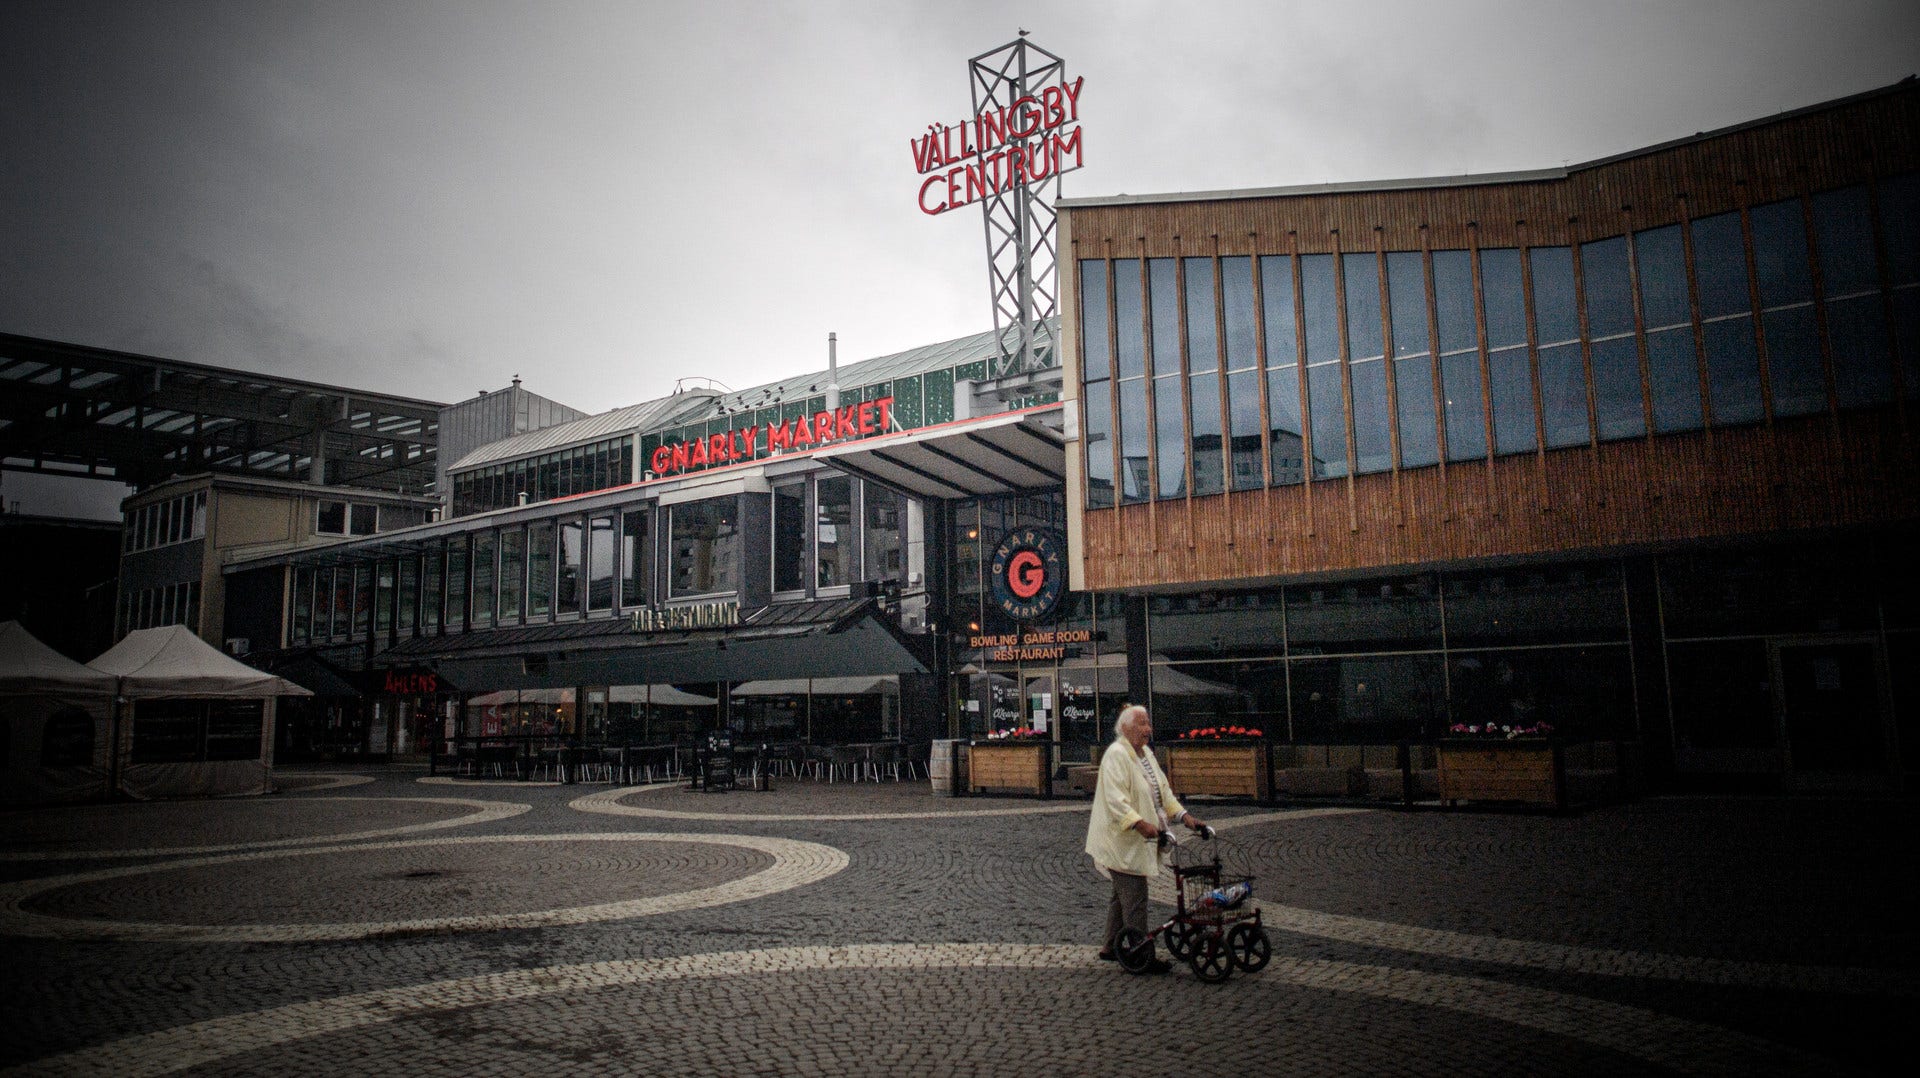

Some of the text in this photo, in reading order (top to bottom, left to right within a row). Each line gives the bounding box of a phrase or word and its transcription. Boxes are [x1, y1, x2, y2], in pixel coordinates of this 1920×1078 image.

[911, 76, 1084, 174] VÄLLINGBY
[918, 125, 1083, 215] CENTRUM
[651, 396, 895, 474] GNARLY MARKET
[992, 532, 1058, 575] GNARLY
[1008, 550, 1045, 598] G
[1003, 592, 1053, 617] MARKET
[970, 630, 1090, 648] BOWLING GAME ROOM
[993, 648, 1065, 662] RESTAURANT
